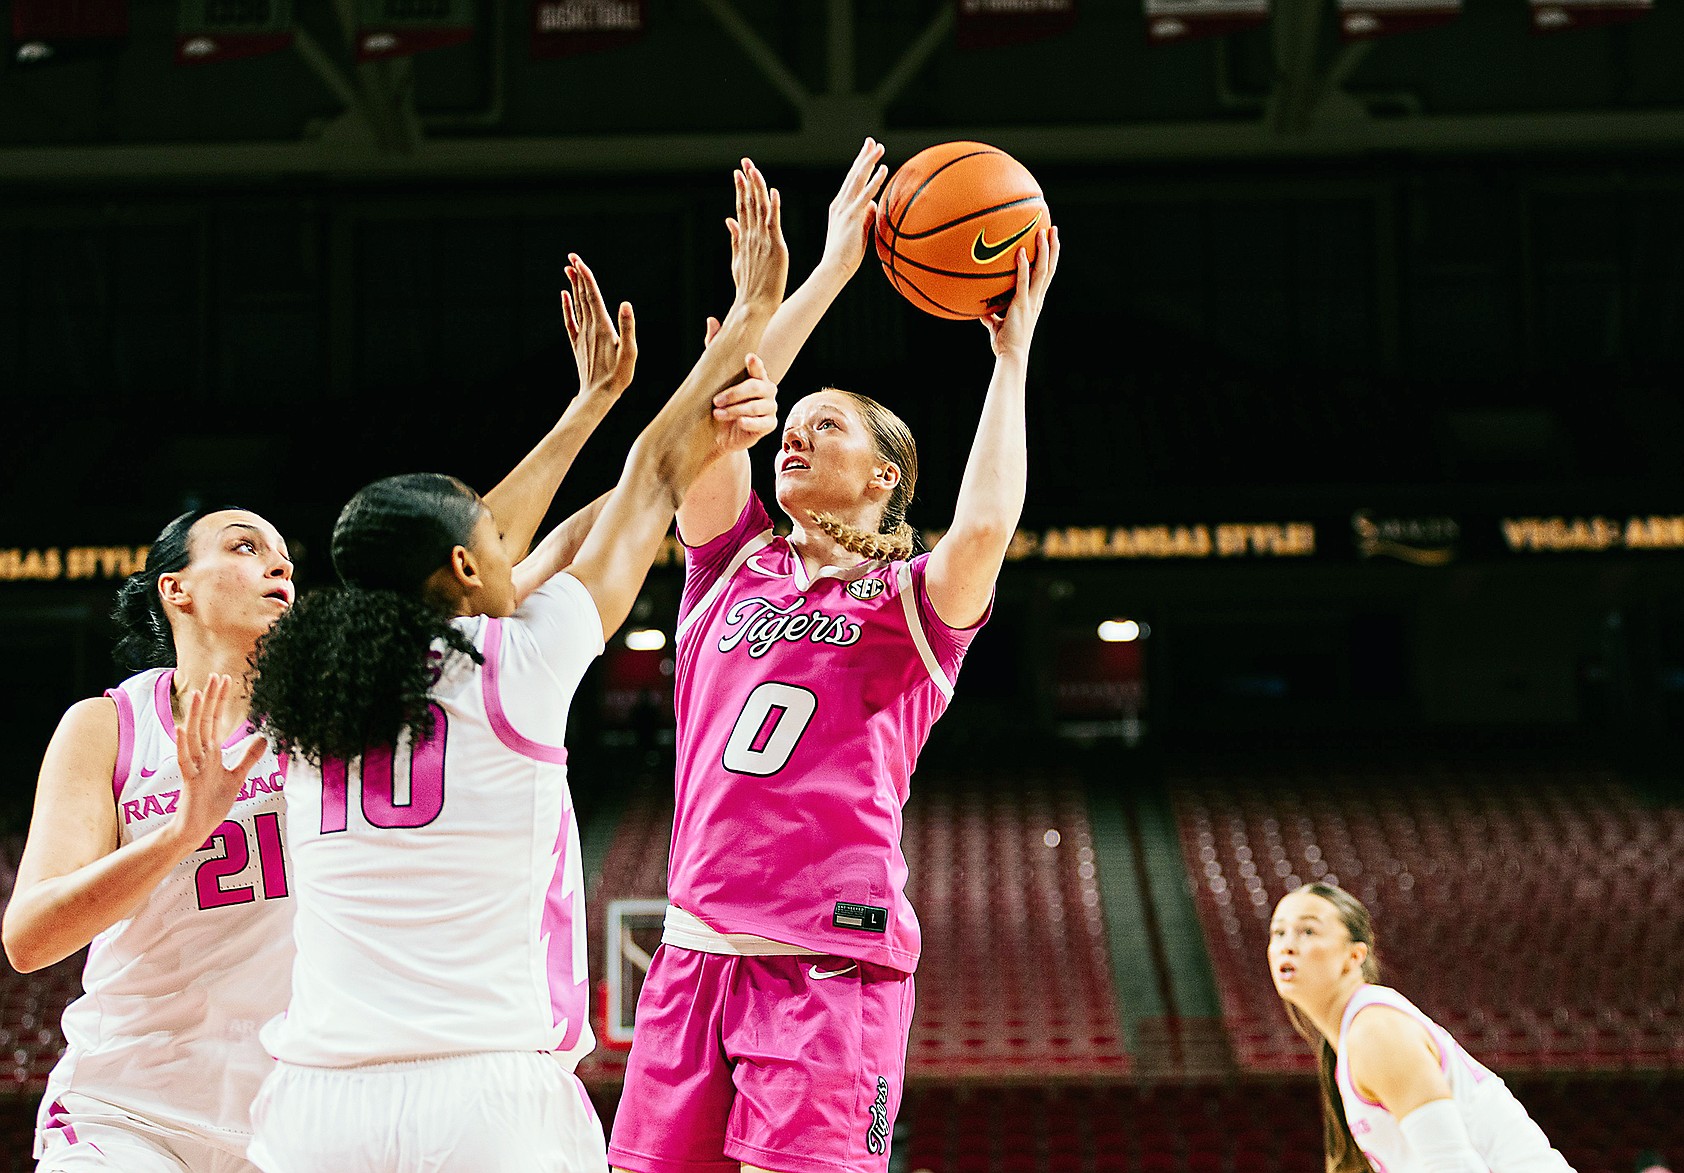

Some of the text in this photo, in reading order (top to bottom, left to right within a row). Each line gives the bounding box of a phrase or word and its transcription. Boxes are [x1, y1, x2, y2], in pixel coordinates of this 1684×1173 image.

[1042, 525, 1210, 560] ARKANSAS
[849, 579, 883, 598] SEC
[718, 597, 861, 658] Tigers
[722, 681, 818, 778] 0
[121, 770, 284, 825] RAZBAC
[319, 701, 448, 835] 10
[195, 812, 289, 911] 21
[871, 913, 877, 924] L
[866, 1075, 890, 1156] Tigers
